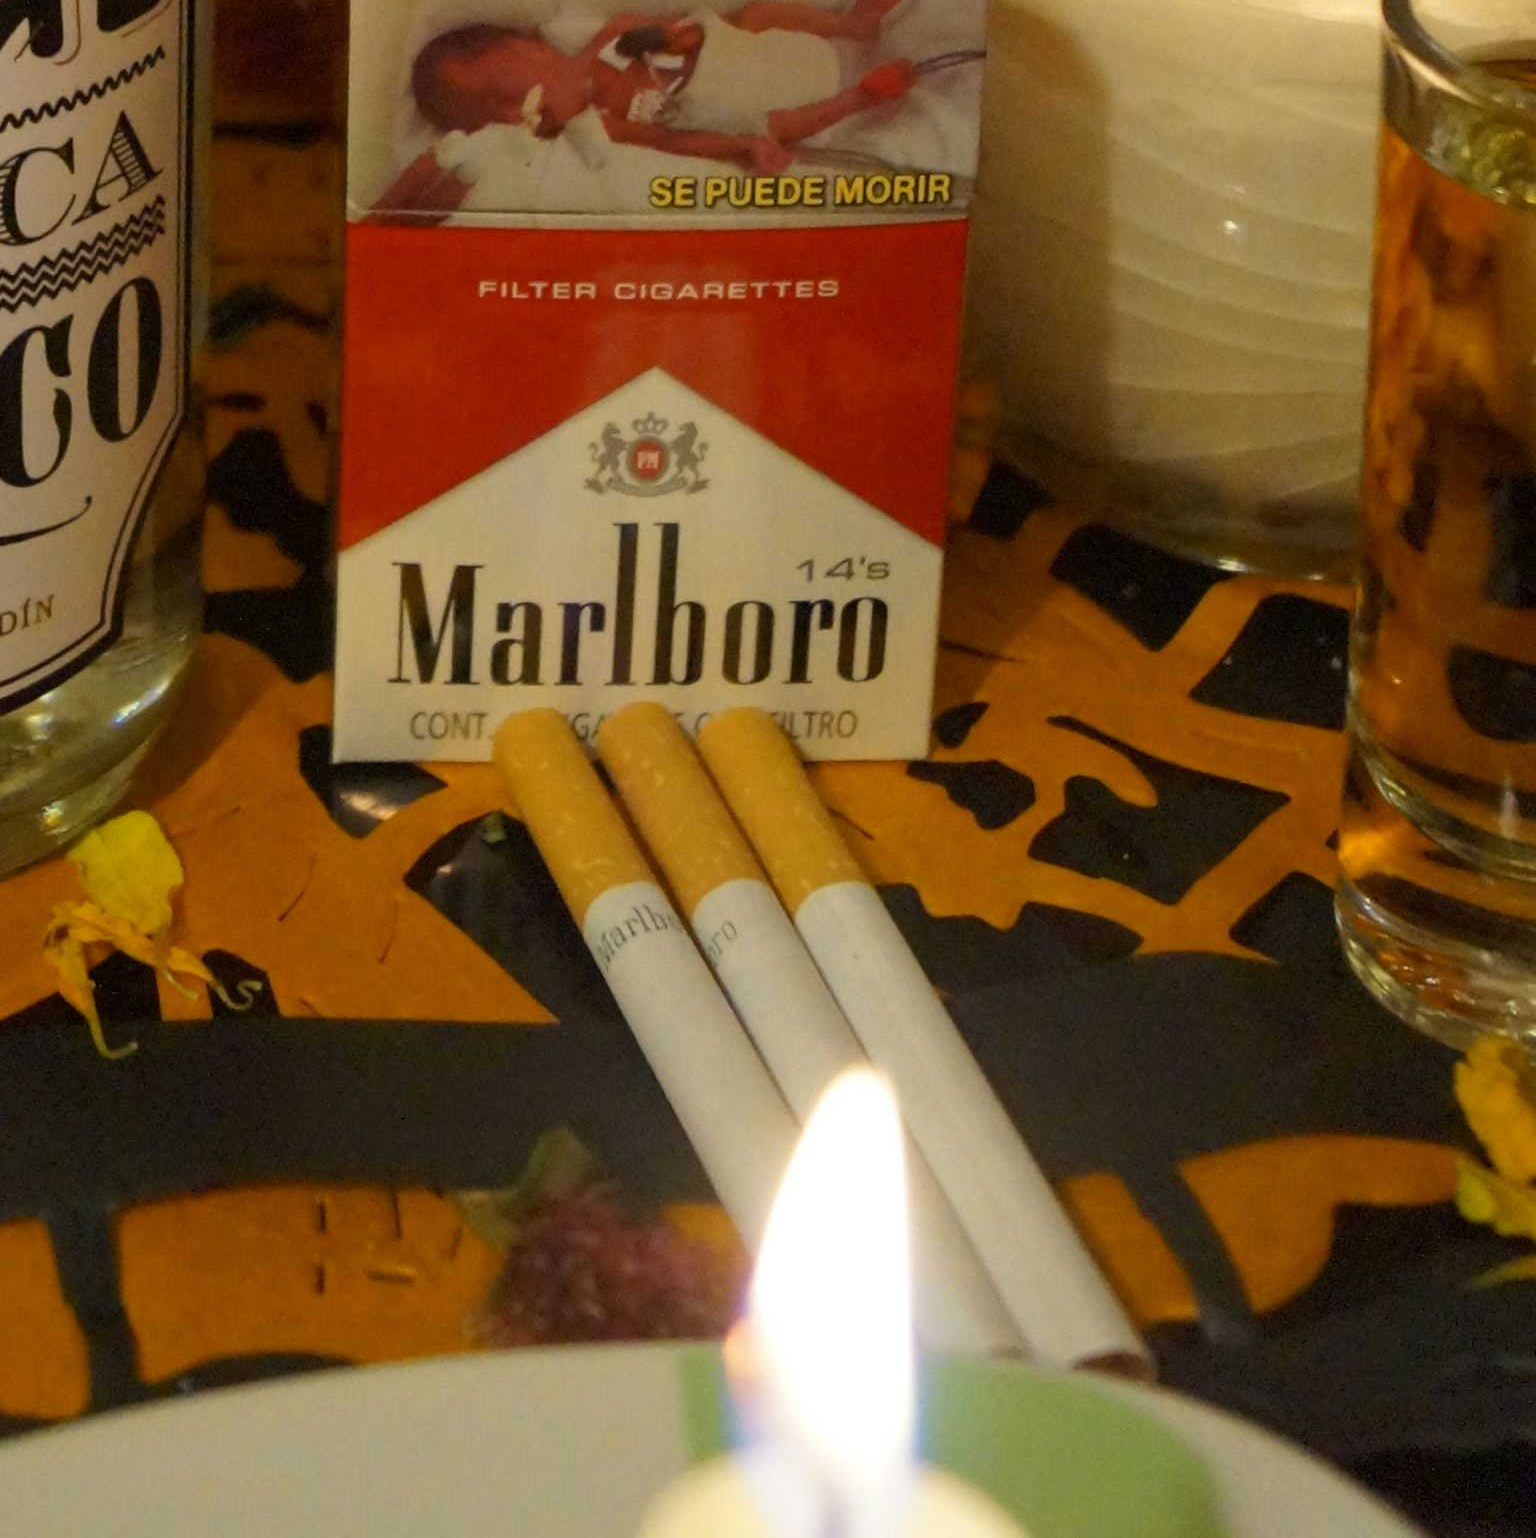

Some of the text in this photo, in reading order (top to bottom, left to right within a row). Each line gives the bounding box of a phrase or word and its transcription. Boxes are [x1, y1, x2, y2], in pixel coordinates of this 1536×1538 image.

[648, 173, 951, 209] SE PUEDE MORIR
[477, 280, 841, 300] FILTER CIGARETTES
[796, 556, 891, 583] 14's
[387, 521, 890, 687] Marlboro
